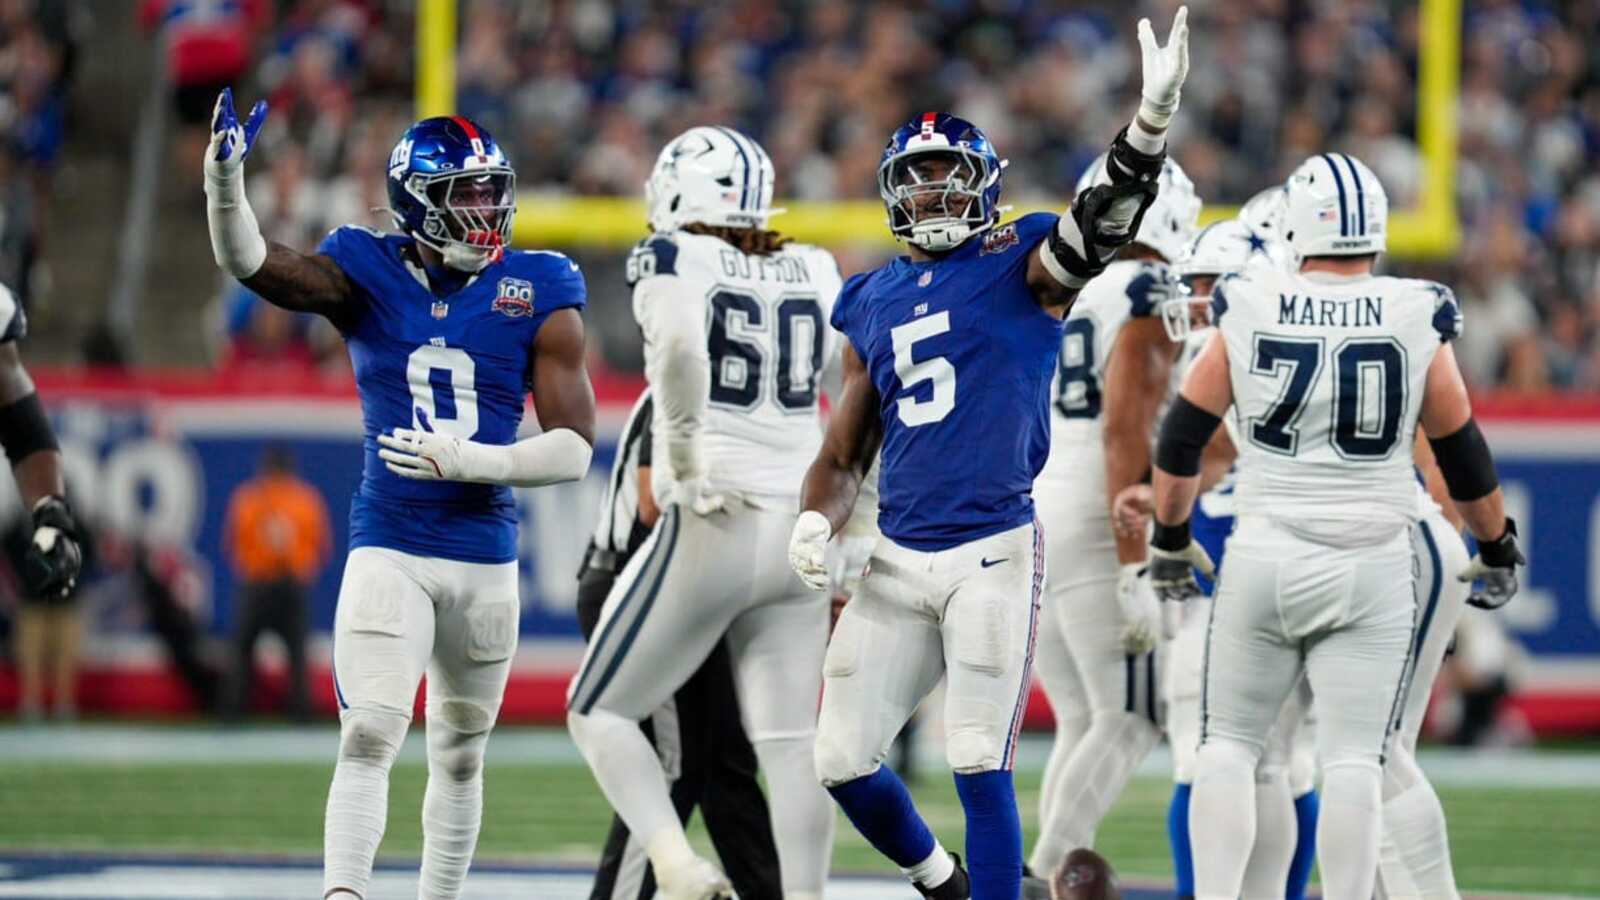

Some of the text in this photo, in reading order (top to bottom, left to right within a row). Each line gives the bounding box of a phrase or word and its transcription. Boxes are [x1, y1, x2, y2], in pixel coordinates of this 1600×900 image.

[921, 121, 935, 135] 5
[500, 282, 532, 302] 100
[626, 253, 657, 282] 60
[1277, 293, 1383, 328] MARTIN
[705, 283, 828, 416] 60
[891, 309, 957, 428] 5
[406, 344, 479, 441] 0
[1249, 330, 1411, 462] 70
